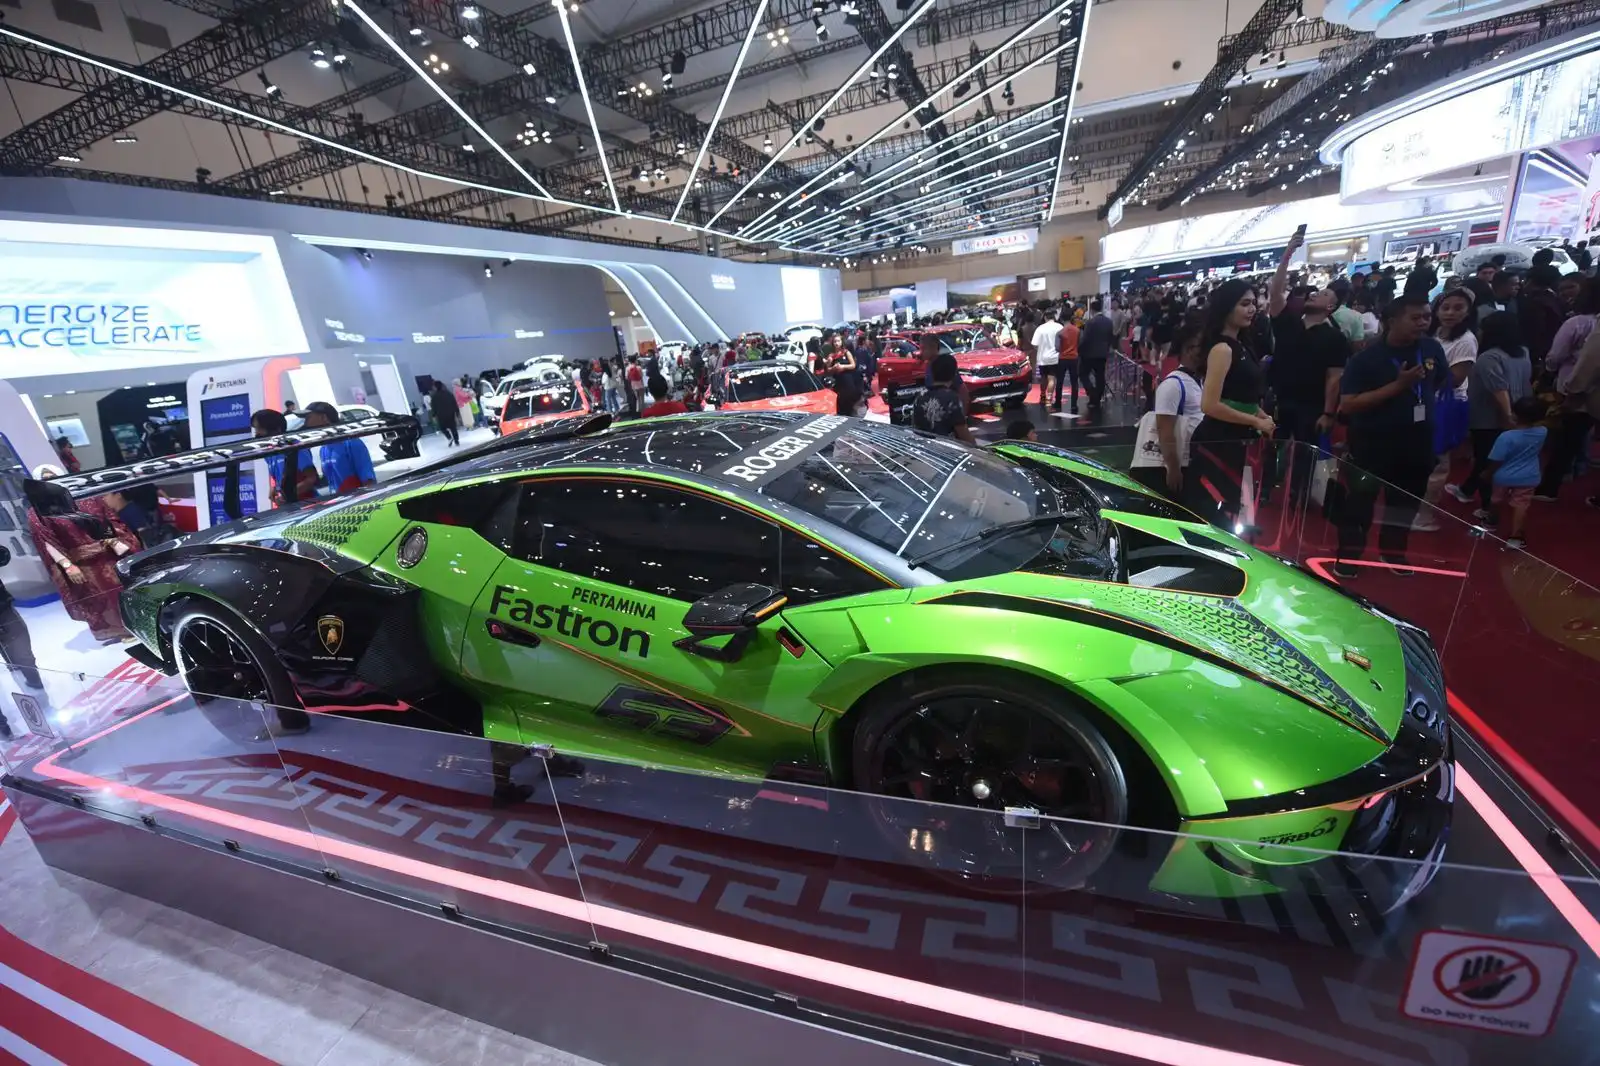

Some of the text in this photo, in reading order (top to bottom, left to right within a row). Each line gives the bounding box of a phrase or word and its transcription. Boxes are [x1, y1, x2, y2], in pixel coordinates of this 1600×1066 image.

[976, 235, 1028, 247] HONDA
[0, 325, 201, 348] ACCELERATE
[216, 379, 247, 389] PERTAMINA
[723, 435, 815, 482] ROGER
[571, 587, 656, 621] PERTAMINA
[489, 585, 651, 659] Fastron
[1258, 828, 1325, 849] TURBO
[1421, 1005, 1530, 1030] DO NOT TOUCH
